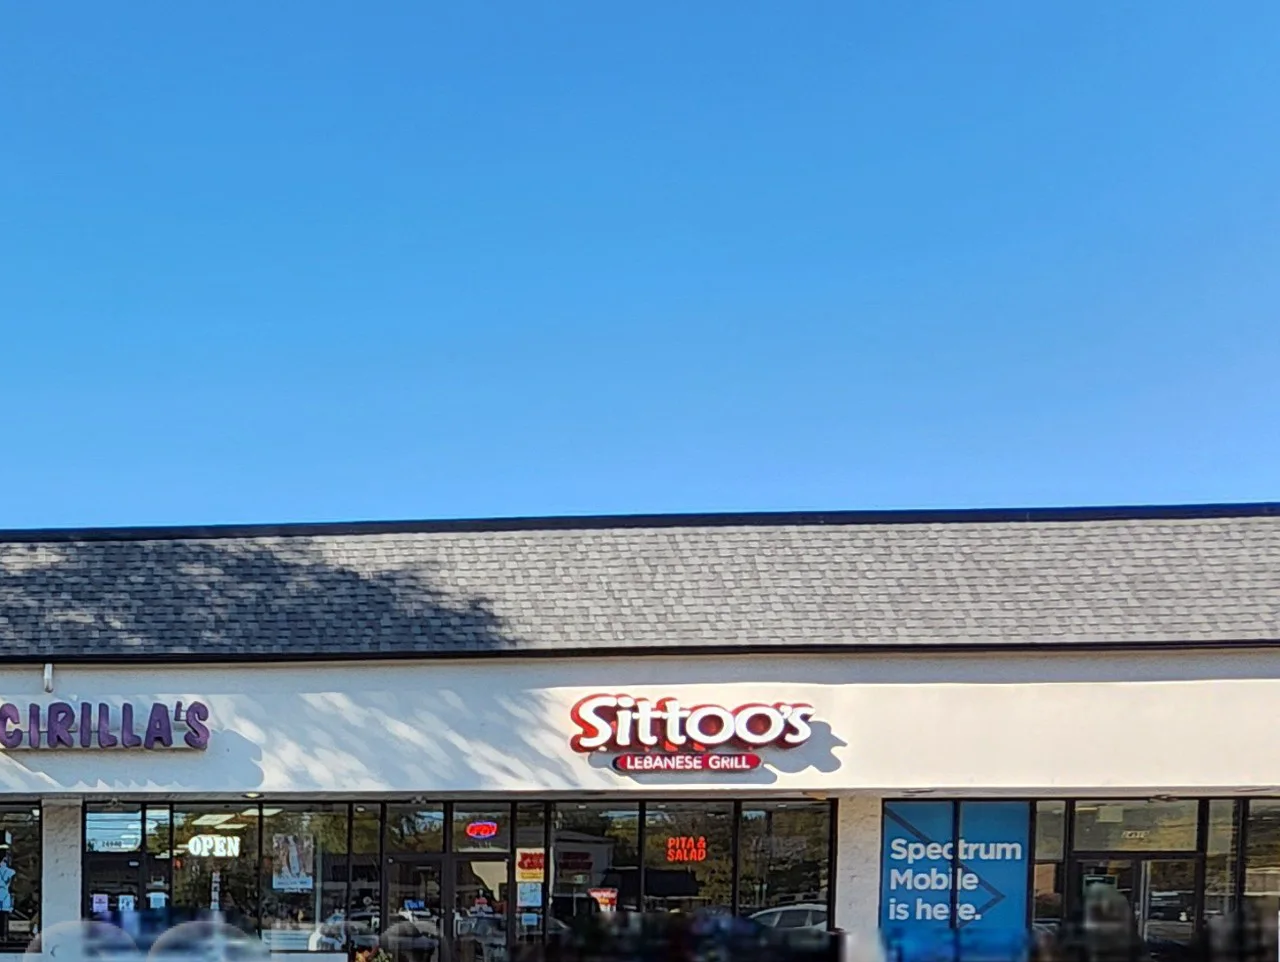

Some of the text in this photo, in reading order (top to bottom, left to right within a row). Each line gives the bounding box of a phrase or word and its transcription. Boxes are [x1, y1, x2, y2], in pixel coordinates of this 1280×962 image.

[571, 694, 816, 751] Sittoo's
[626, 756, 751, 770] LEBANESE GRILL
[188, 834, 240, 857] OPEN
[667, 836, 706, 849] PITA &
[890, 838, 1022, 864] Spectrum
[667, 849, 706, 861] SALAD
[890, 868, 979, 890] Mobile
[888, 898, 982, 920] is hee.
